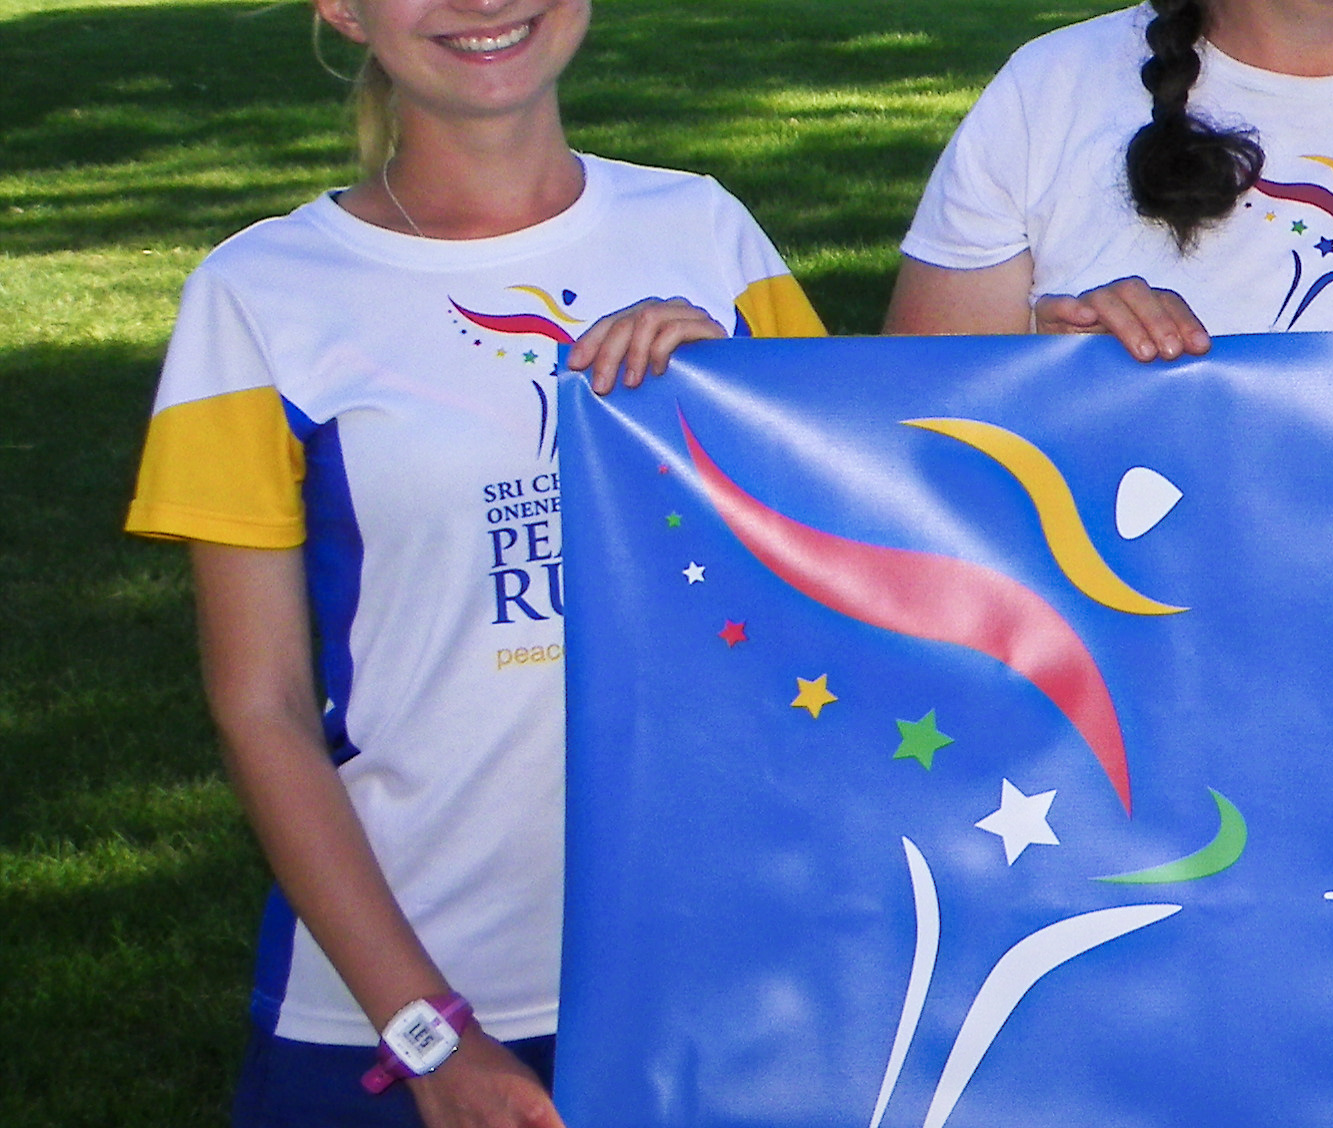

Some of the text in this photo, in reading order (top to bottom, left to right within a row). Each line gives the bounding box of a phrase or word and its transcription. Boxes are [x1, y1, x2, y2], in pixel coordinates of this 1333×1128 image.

[484, 479, 524, 503] SRI
[487, 521, 562, 568] PE
[497, 643, 565, 670] peac
